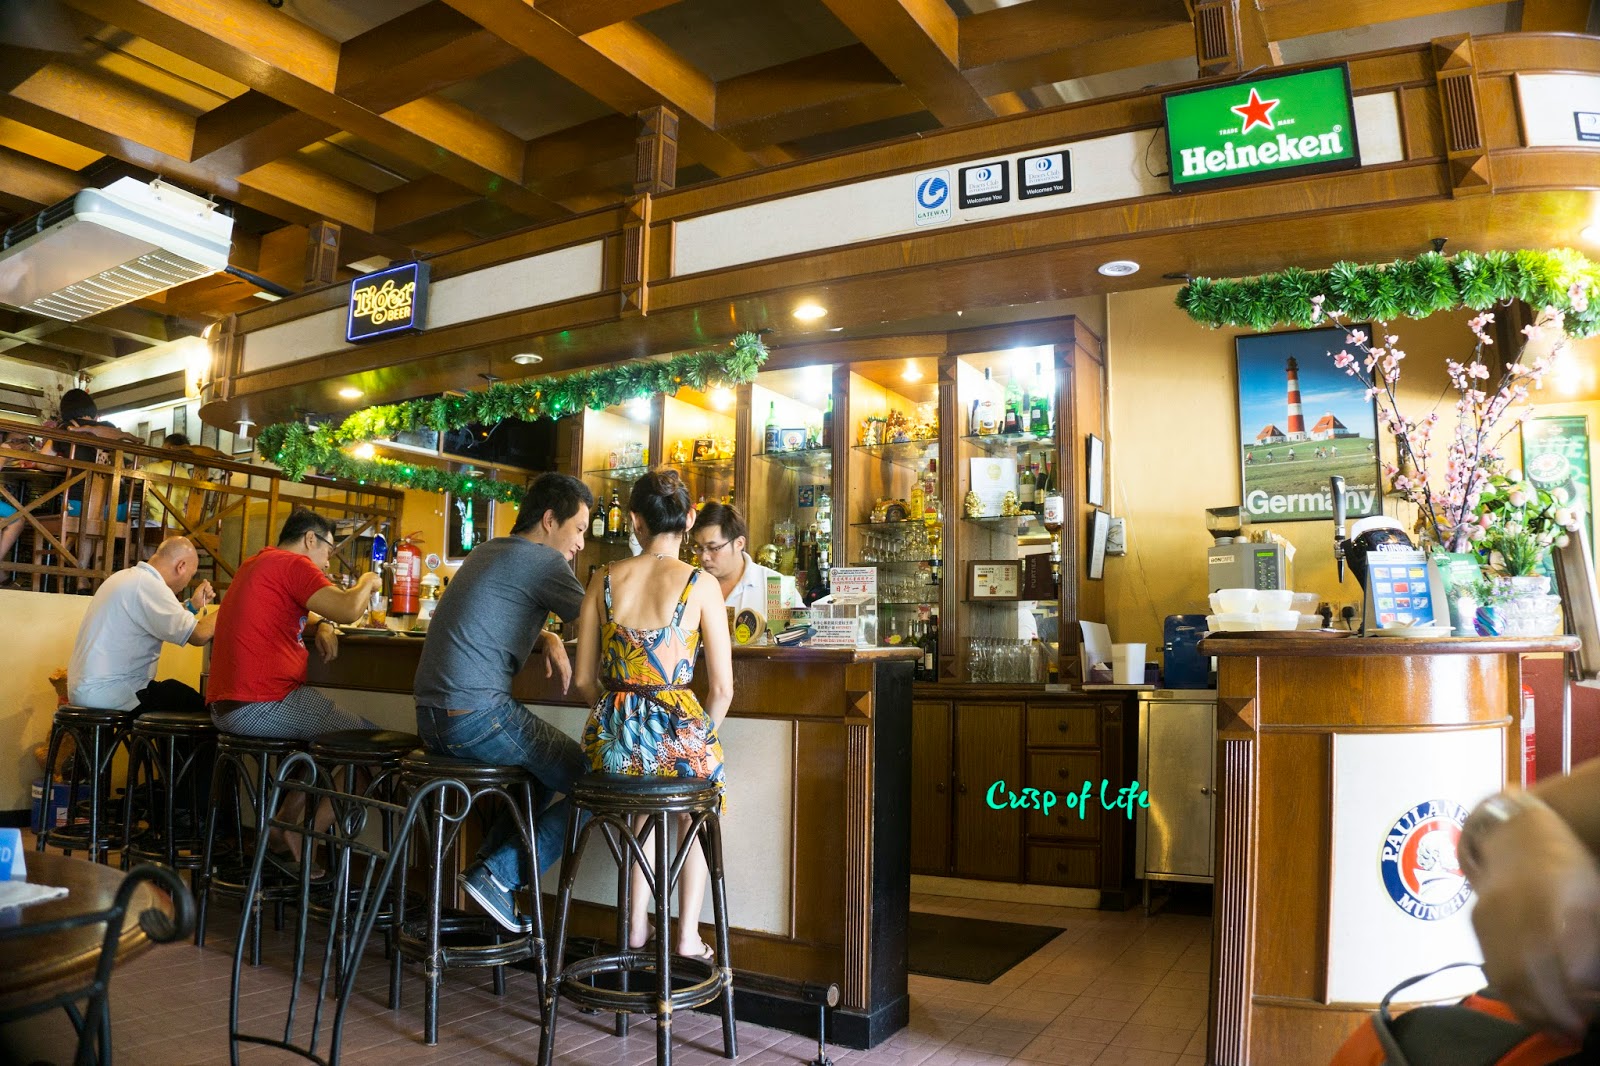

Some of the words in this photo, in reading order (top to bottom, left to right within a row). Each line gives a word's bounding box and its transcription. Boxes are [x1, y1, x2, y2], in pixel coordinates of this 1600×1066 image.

[1219, 128, 1238, 136] TRADE
[1278, 118, 1295, 127] MARK
[1179, 131, 1343, 176] Heineken
[1026, 186, 1053, 195] Welcomes
[966, 196, 992, 204] Welcomes
[917, 208, 949, 219] GATEWAY
[353, 279, 416, 325] Tiger
[387, 306, 411, 321] BEER
[1381, 800, 1470, 862] PAULANE
[1396, 880, 1473, 920] MÜNCHE
